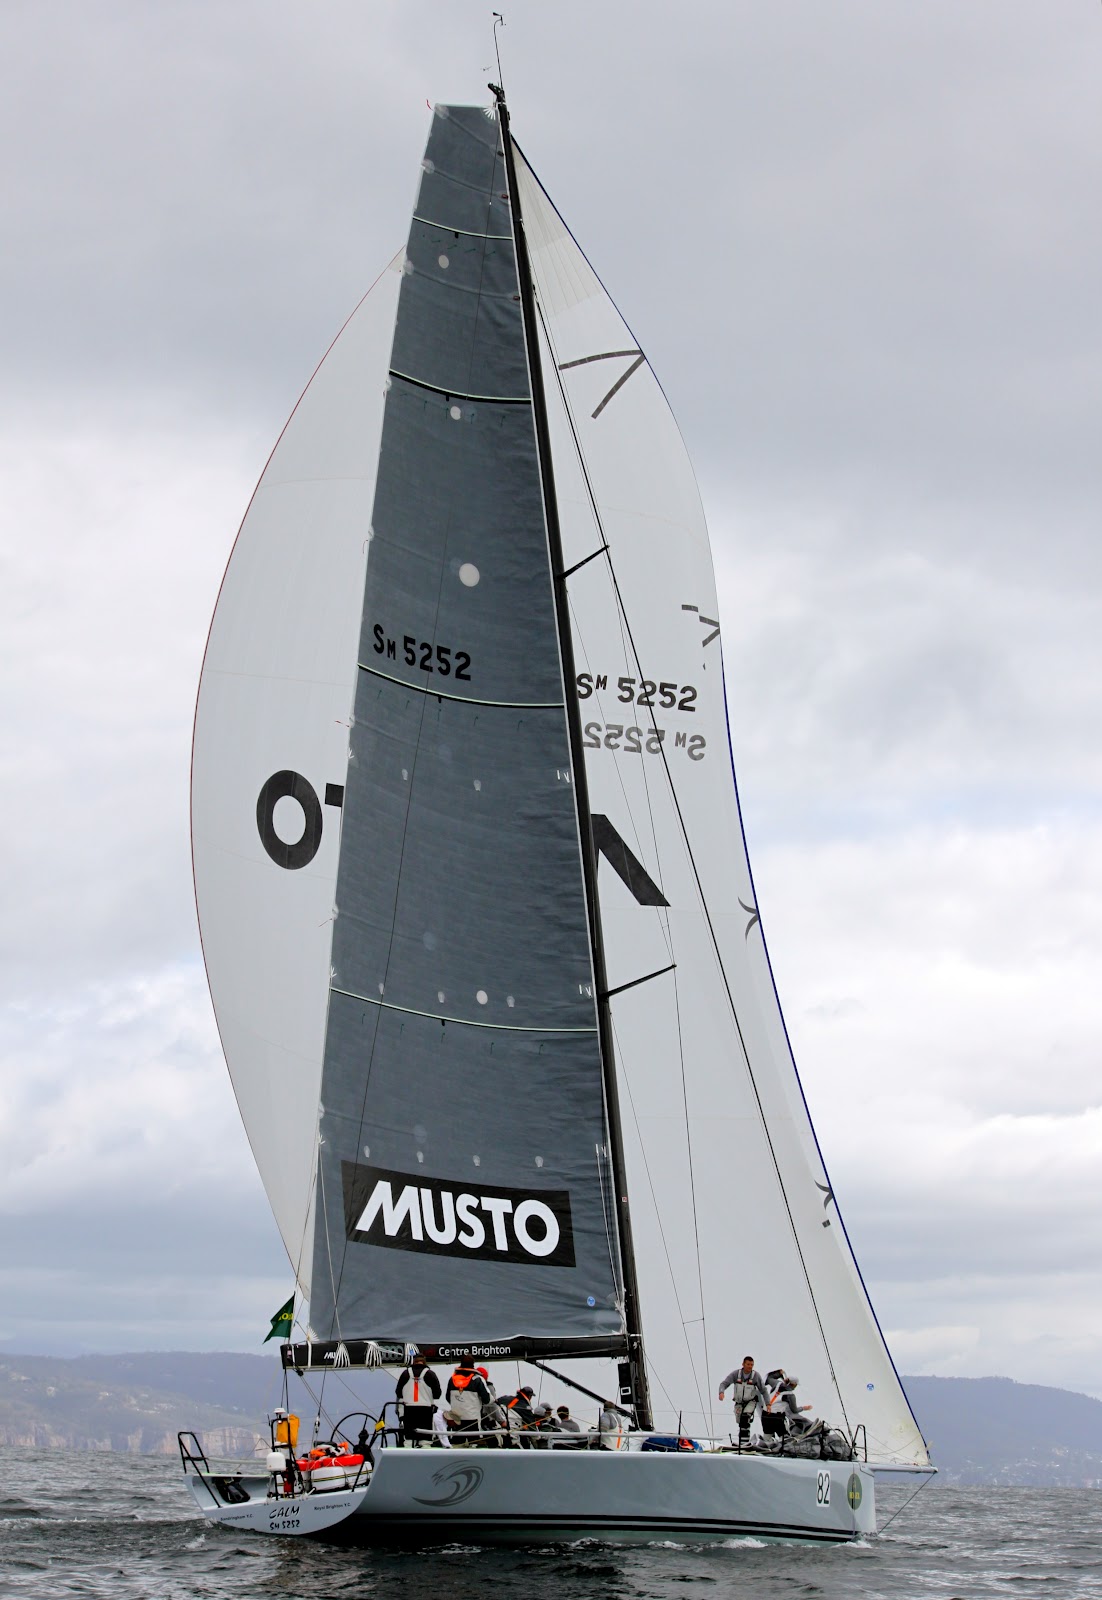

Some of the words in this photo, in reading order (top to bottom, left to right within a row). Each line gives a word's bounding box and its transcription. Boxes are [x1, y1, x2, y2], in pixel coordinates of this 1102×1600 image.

[404, 635, 471, 681] 5252
[617, 677, 698, 712] 5252
[355, 1180, 561, 1257] MUSTO
[438, 1346, 470, 1357] Centre
[471, 1345, 511, 1358] Brighton
[817, 1472, 830, 1505] 82
[269, 1505, 300, 1519] CALM
[282, 1519, 300, 1530] 5252
